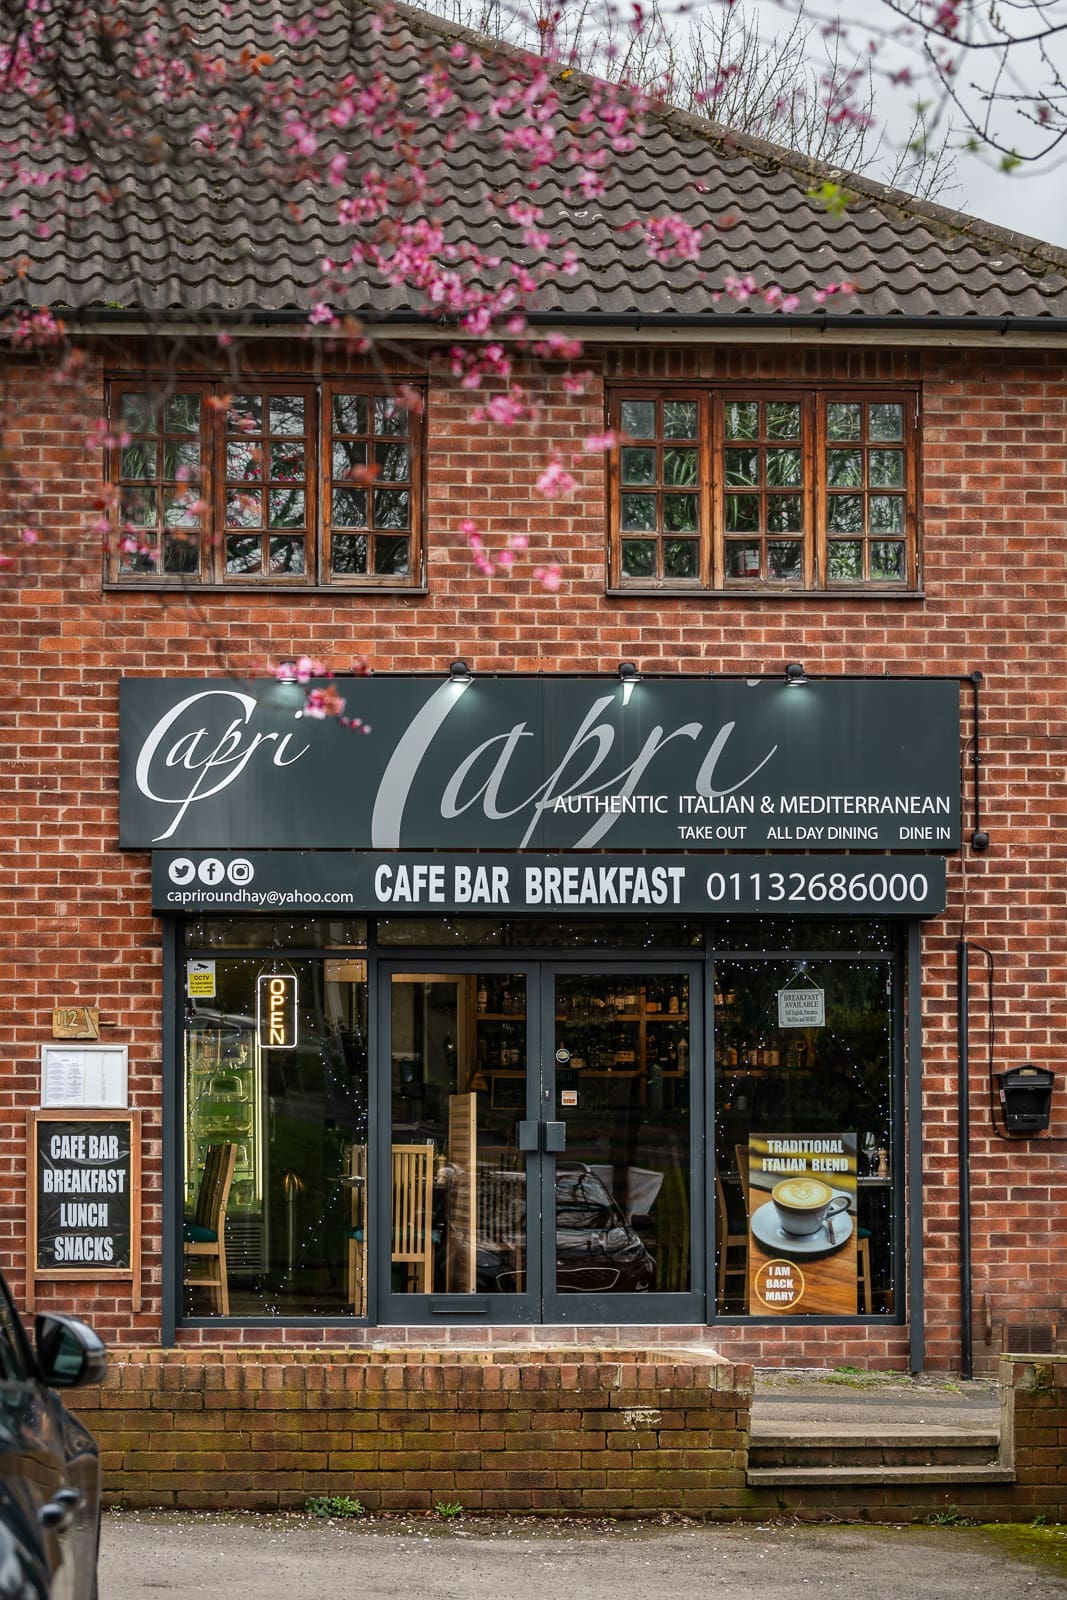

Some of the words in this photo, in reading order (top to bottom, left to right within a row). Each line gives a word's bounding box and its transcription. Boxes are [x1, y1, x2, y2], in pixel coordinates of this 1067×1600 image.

[135, 689, 309, 842] Capri
[553, 795, 669, 814] AUTHENTIC
[679, 795, 754, 814] ITALIAN
[760, 795, 775, 814] &
[780, 796, 950, 814] MEDITERRANEAN
[678, 826, 713, 840] TAKE
[716, 826, 747, 840] OUT
[767, 826, 792, 840] ALL
[796, 826, 824, 840] DAY
[827, 826, 879, 840] DINING
[899, 826, 933, 840] DINE
[936, 827, 951, 840] IN
[374, 864, 445, 903] CAFE
[454, 866, 510, 904] BAR
[525, 866, 686, 905] BREAKFAST
[706, 872, 928, 902] 01132686000
[167, 889, 354, 906] capriroundhay@yahoo.com
[784, 993, 819, 1001] BREAKFAST
[55, 1010, 79, 1027] 112
[269, 979, 286, 1045] OPEN
[50, 1135, 86, 1160] CAFE
[88, 1135, 119, 1160] BAR
[766, 1140, 844, 1154] TRADITIONAL
[762, 1158, 807, 1172] ITALIAN
[811, 1158, 849, 1172] BLEND
[43, 1169, 126, 1193] BREAKFAST
[60, 1203, 109, 1228] LUNCH
[54, 1236, 114, 1261] SNACKS
[768, 1266, 773, 1276] I
[775, 1266, 791, 1276] AM
[765, 1279, 794, 1289] BACK
[765, 1291, 794, 1301] MARY
